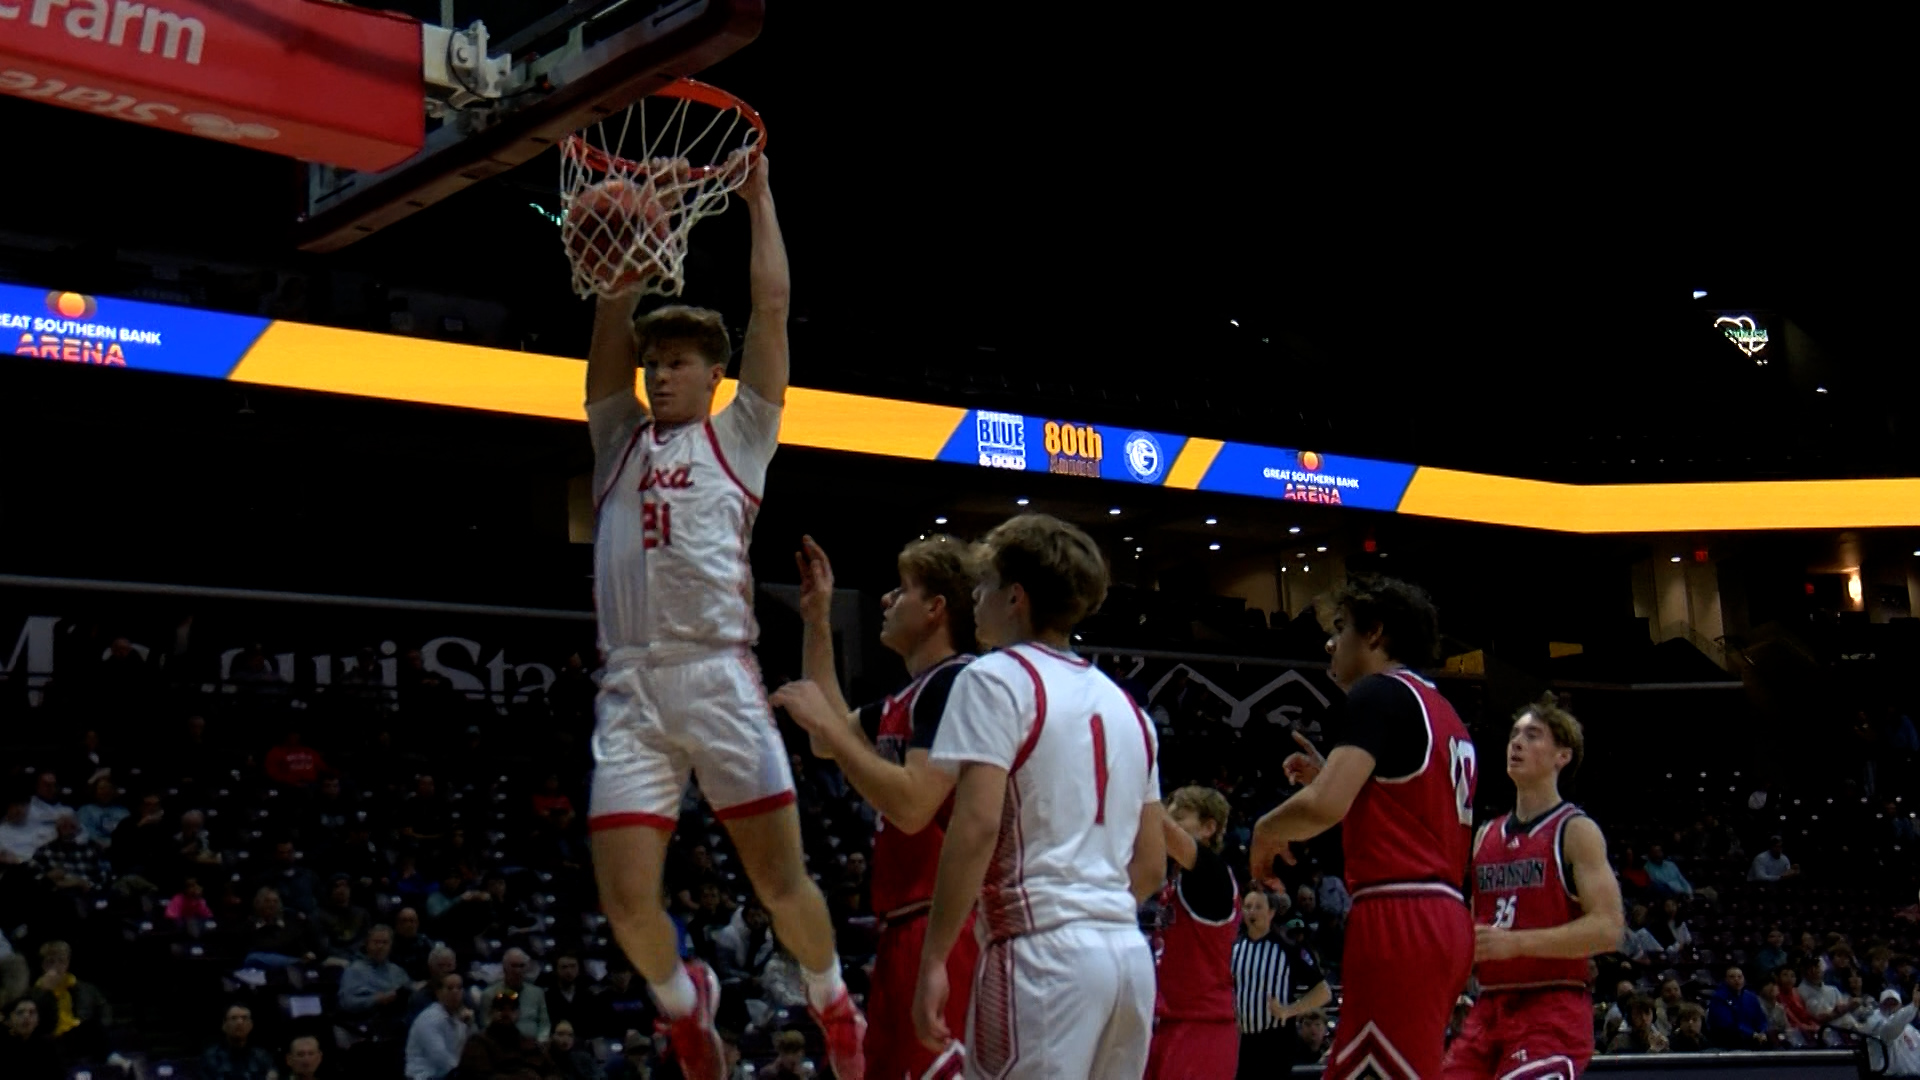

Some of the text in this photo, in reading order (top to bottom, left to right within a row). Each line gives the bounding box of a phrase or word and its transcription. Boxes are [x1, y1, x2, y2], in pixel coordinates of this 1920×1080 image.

[0, 313, 161, 345] EAT SOUTHERN BANK
[15, 332, 127, 368] ARENA
[978, 418, 1024, 446] BLUE
[1044, 421, 1103, 461] 80th
[1263, 467, 1359, 489] GREAT SOUTHERN BANK
[1284, 482, 1342, 505] ARENA
[1090, 714, 1107, 825] 1
